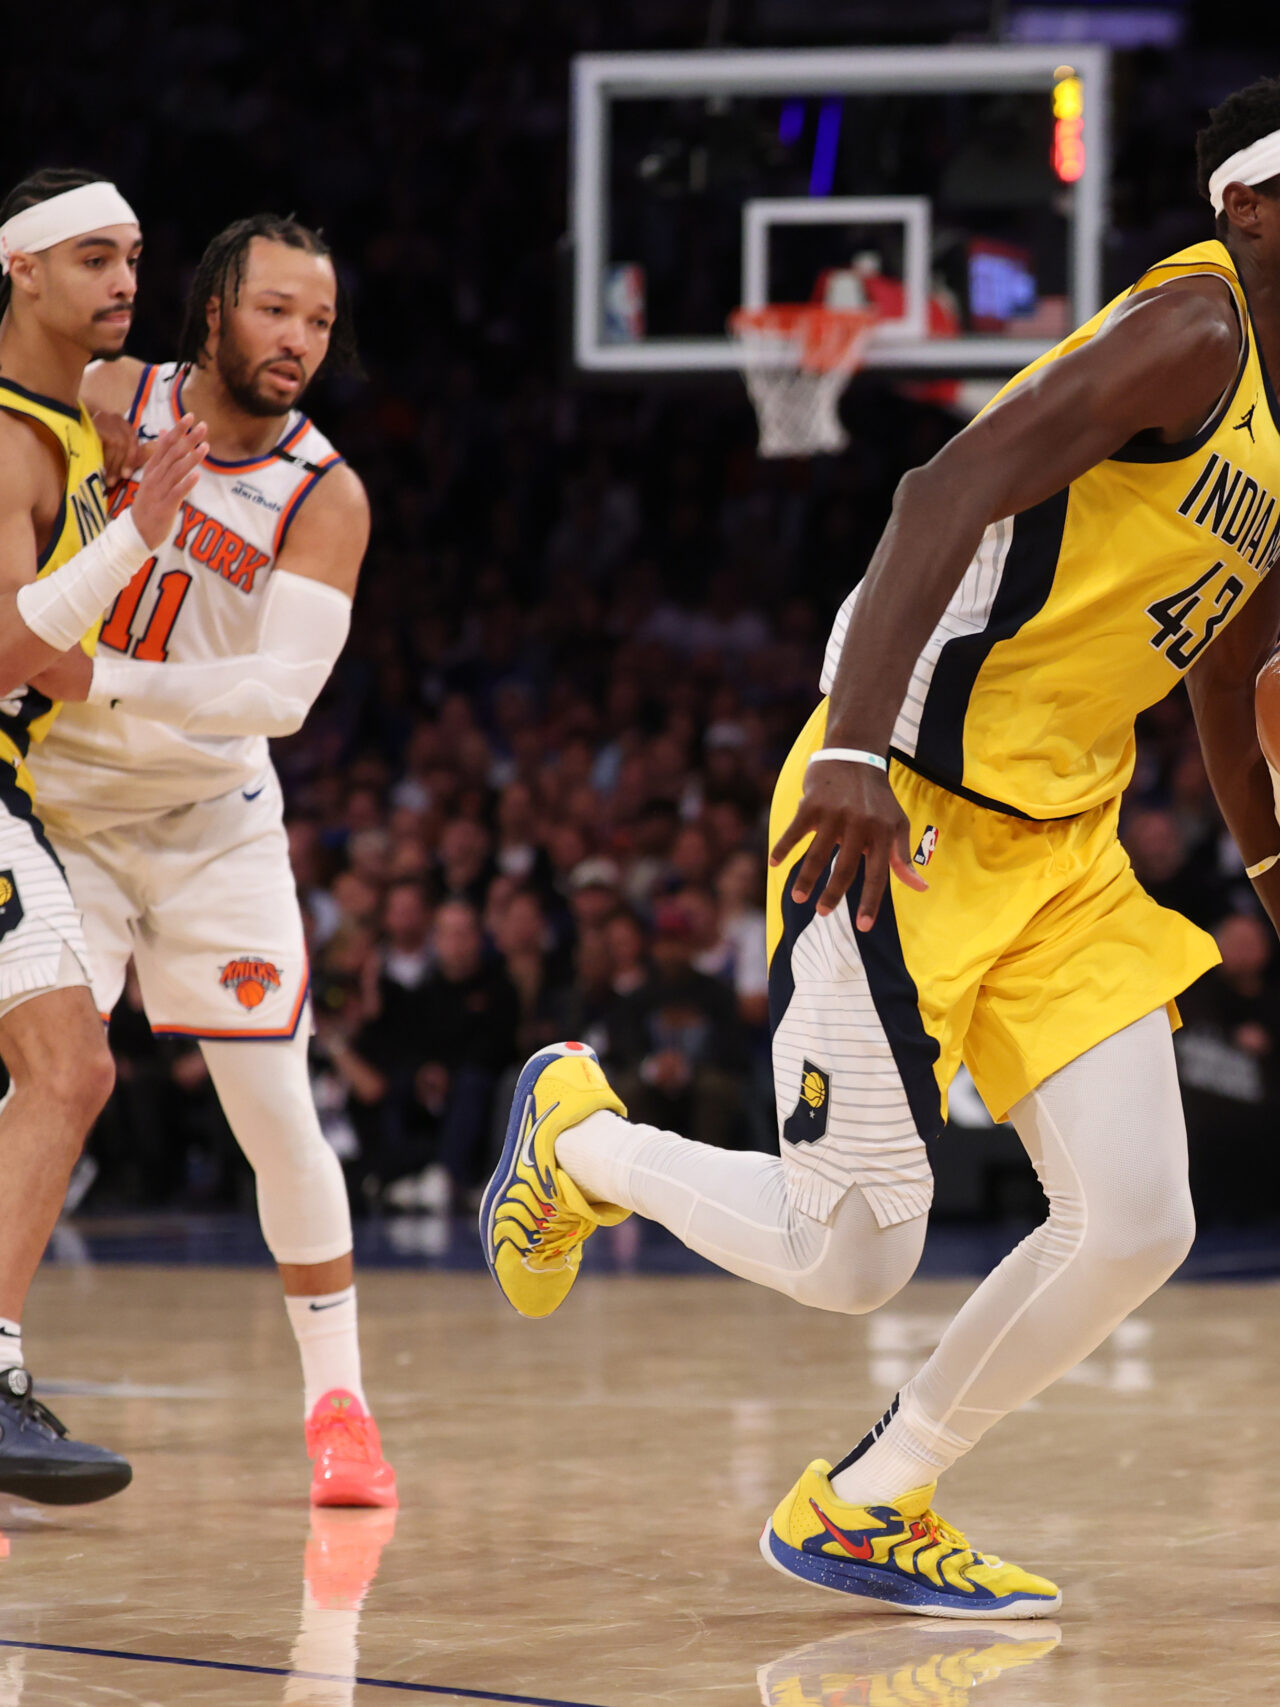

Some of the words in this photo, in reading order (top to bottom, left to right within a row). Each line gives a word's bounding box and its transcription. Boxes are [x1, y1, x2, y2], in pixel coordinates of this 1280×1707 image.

[173, 500, 270, 594] YORK
[99, 556, 192, 662] 11
[1144, 559, 1245, 671] 43
